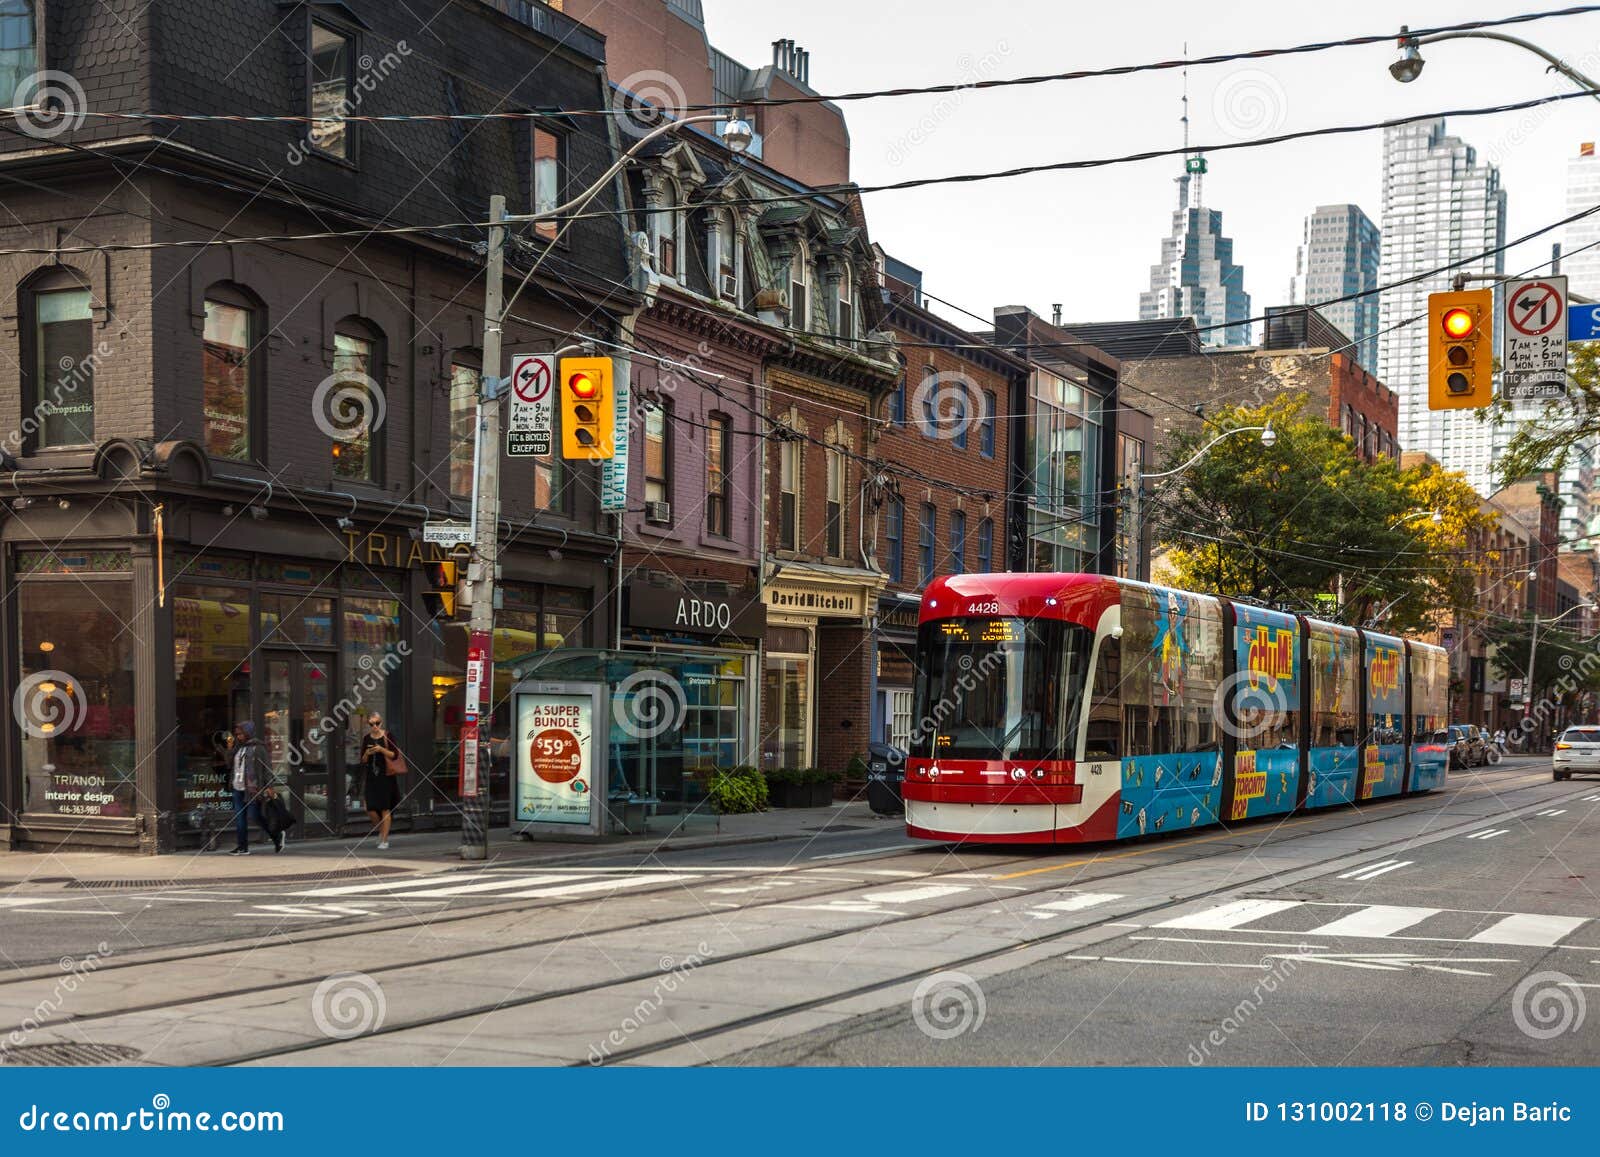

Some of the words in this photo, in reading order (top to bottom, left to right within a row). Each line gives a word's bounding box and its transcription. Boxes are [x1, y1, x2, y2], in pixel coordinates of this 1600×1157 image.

[1543, 360, 1557, 368] FRI
[1505, 374, 1519, 383] TTC
[1529, 372, 1565, 382] BICYCLES
[1509, 386, 1560, 397] EXCEPTED
[615, 389, 628, 457] INSTITUTE
[526, 433, 550, 441] BICYCLES
[602, 458, 613, 511] INTEGRA
[613, 463, 625, 510] HEALTH
[426, 532, 461, 541] SHERBOURNE
[675, 598, 730, 629] ARDO
[968, 603, 998, 614] 4428
[534, 705, 541, 715] A
[544, 705, 580, 716] SUPER
[535, 717, 579, 728] BUNDLE
[54, 775, 105, 786] TRIANON
[1236, 775, 1265, 797] TORONTO
[45, 790, 81, 800] interior
[83, 791, 114, 804] design
